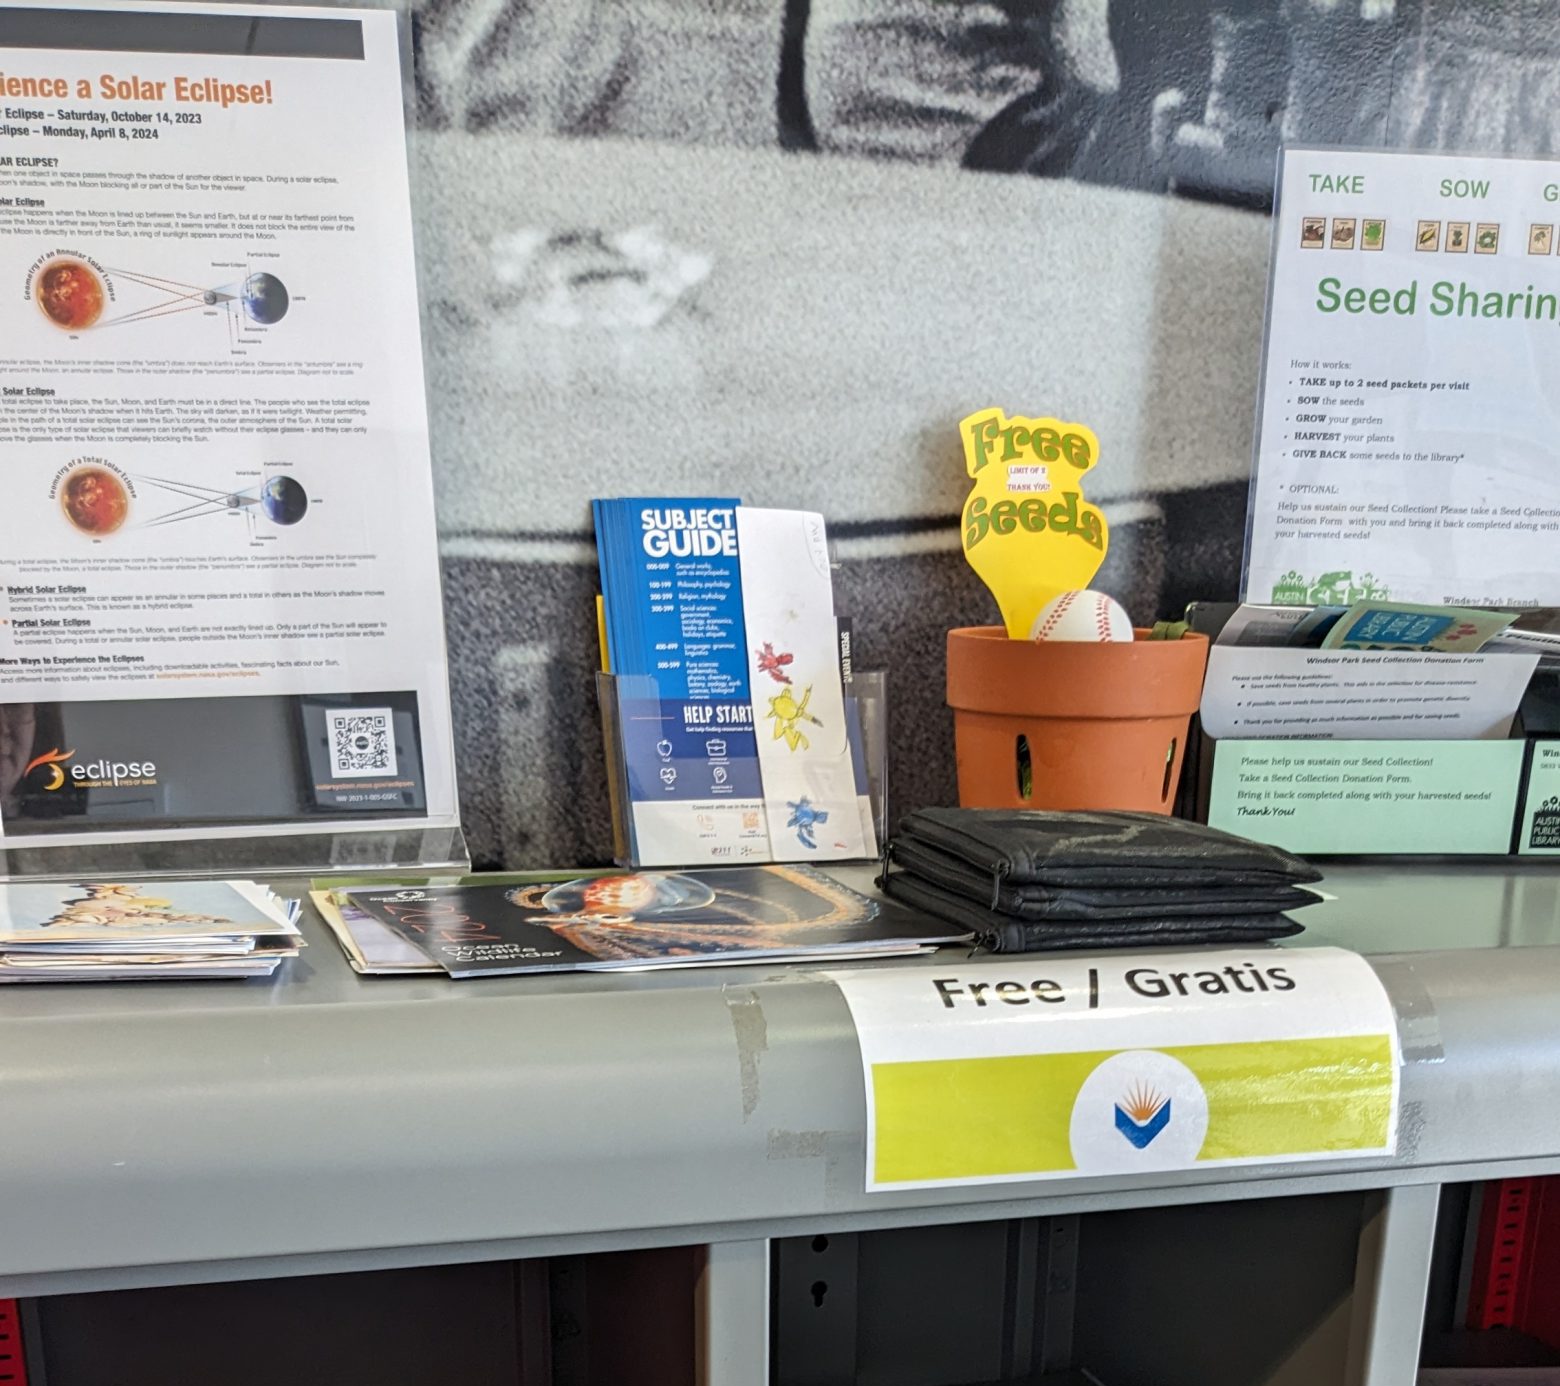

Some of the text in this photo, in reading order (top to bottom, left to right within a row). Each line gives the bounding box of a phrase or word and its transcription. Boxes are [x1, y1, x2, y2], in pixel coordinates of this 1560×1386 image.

[77, 79, 92, 99] a
[100, 75, 166, 100] Solar
[174, 77, 272, 107] Eclipse!
[5, 108, 202, 125] Eclipse Saturday, October 14, 2023
[42, 126, 88, 139] Monday,
[91, 127, 116, 140] April
[119, 128, 129, 140] 8,
[131, 128, 159, 139] 2024
[15, 157, 59, 167] ECLIPSE?
[1309, 174, 1365, 194] TAKE
[1440, 179, 1490, 198] SOW
[1316, 278, 1557, 319] Seed Sharin
[1290, 359, 1352, 369] How it works:
[1299, 377, 1470, 391] TAKE up to 2 seed packets per visit
[2, 387, 55, 396] Solar Eclipse
[1297, 396, 1364, 406] SOW the seeds
[1296, 414, 1383, 425] GROW your garden
[1294, 432, 1341, 441] HARVEST
[1366, 434, 1394, 443] plants
[970, 416, 1091, 475] Free
[1292, 449, 1317, 458] GIVE
[1319, 450, 1347, 459] BACK
[1376, 452, 1400, 460] seeds
[1414, 452, 1428, 461] the
[1008, 483, 1031, 491] THANK
[1289, 484, 1339, 494] OPTIONAL:
[641, 509, 733, 530] SUBJECT
[965, 491, 1103, 551] Seeds
[643, 529, 738, 558] GUIDE
[7, 585, 87, 595] Hybrid Solar Eclipse
[11, 618, 91, 628] Partial Solar Eclipse
[841, 632, 850, 659] SPECIAL
[19, 657, 41, 666] Ways
[52, 656, 96, 665] Experience
[112, 655, 145, 663] Eclipses
[683, 705, 754, 724] HELP START
[1241, 757, 1269, 765] Please
[1271, 757, 1291, 767] help
[1307, 758, 1341, 766] sustain
[1361, 757, 1384, 766] Seed
[1385, 757, 1434, 766] Collection!
[72, 760, 156, 786] eclipse
[1237, 806, 1296, 816] Thank You!
[441, 943, 519, 951] Ocean
[446, 946, 537, 957] Wildlife
[455, 951, 564, 962] Calendar
[932, 978, 1066, 1009] Free
[1124, 962, 1297, 999] Gratis
